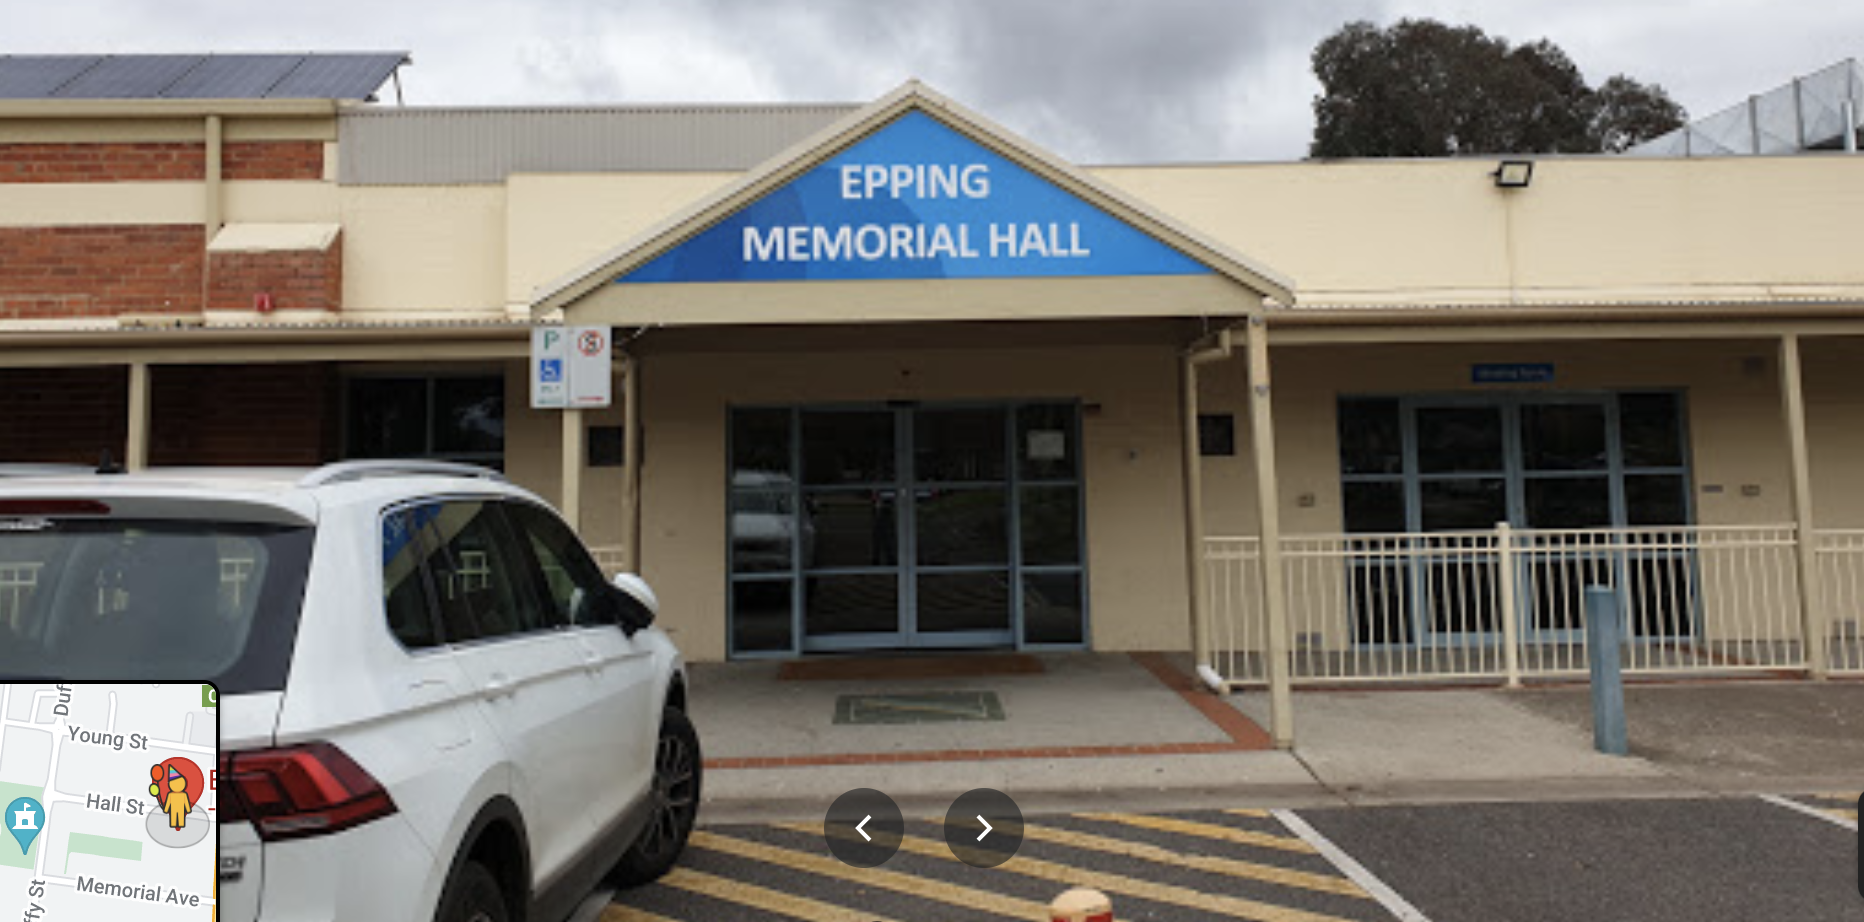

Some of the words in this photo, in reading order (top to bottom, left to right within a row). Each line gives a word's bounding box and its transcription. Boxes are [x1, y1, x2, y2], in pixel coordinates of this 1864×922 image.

[841, 164, 990, 199] EPPING
[742, 224, 979, 261] MEMORIAL
[989, 222, 1090, 257] HALL
[544, 330, 559, 350] P
